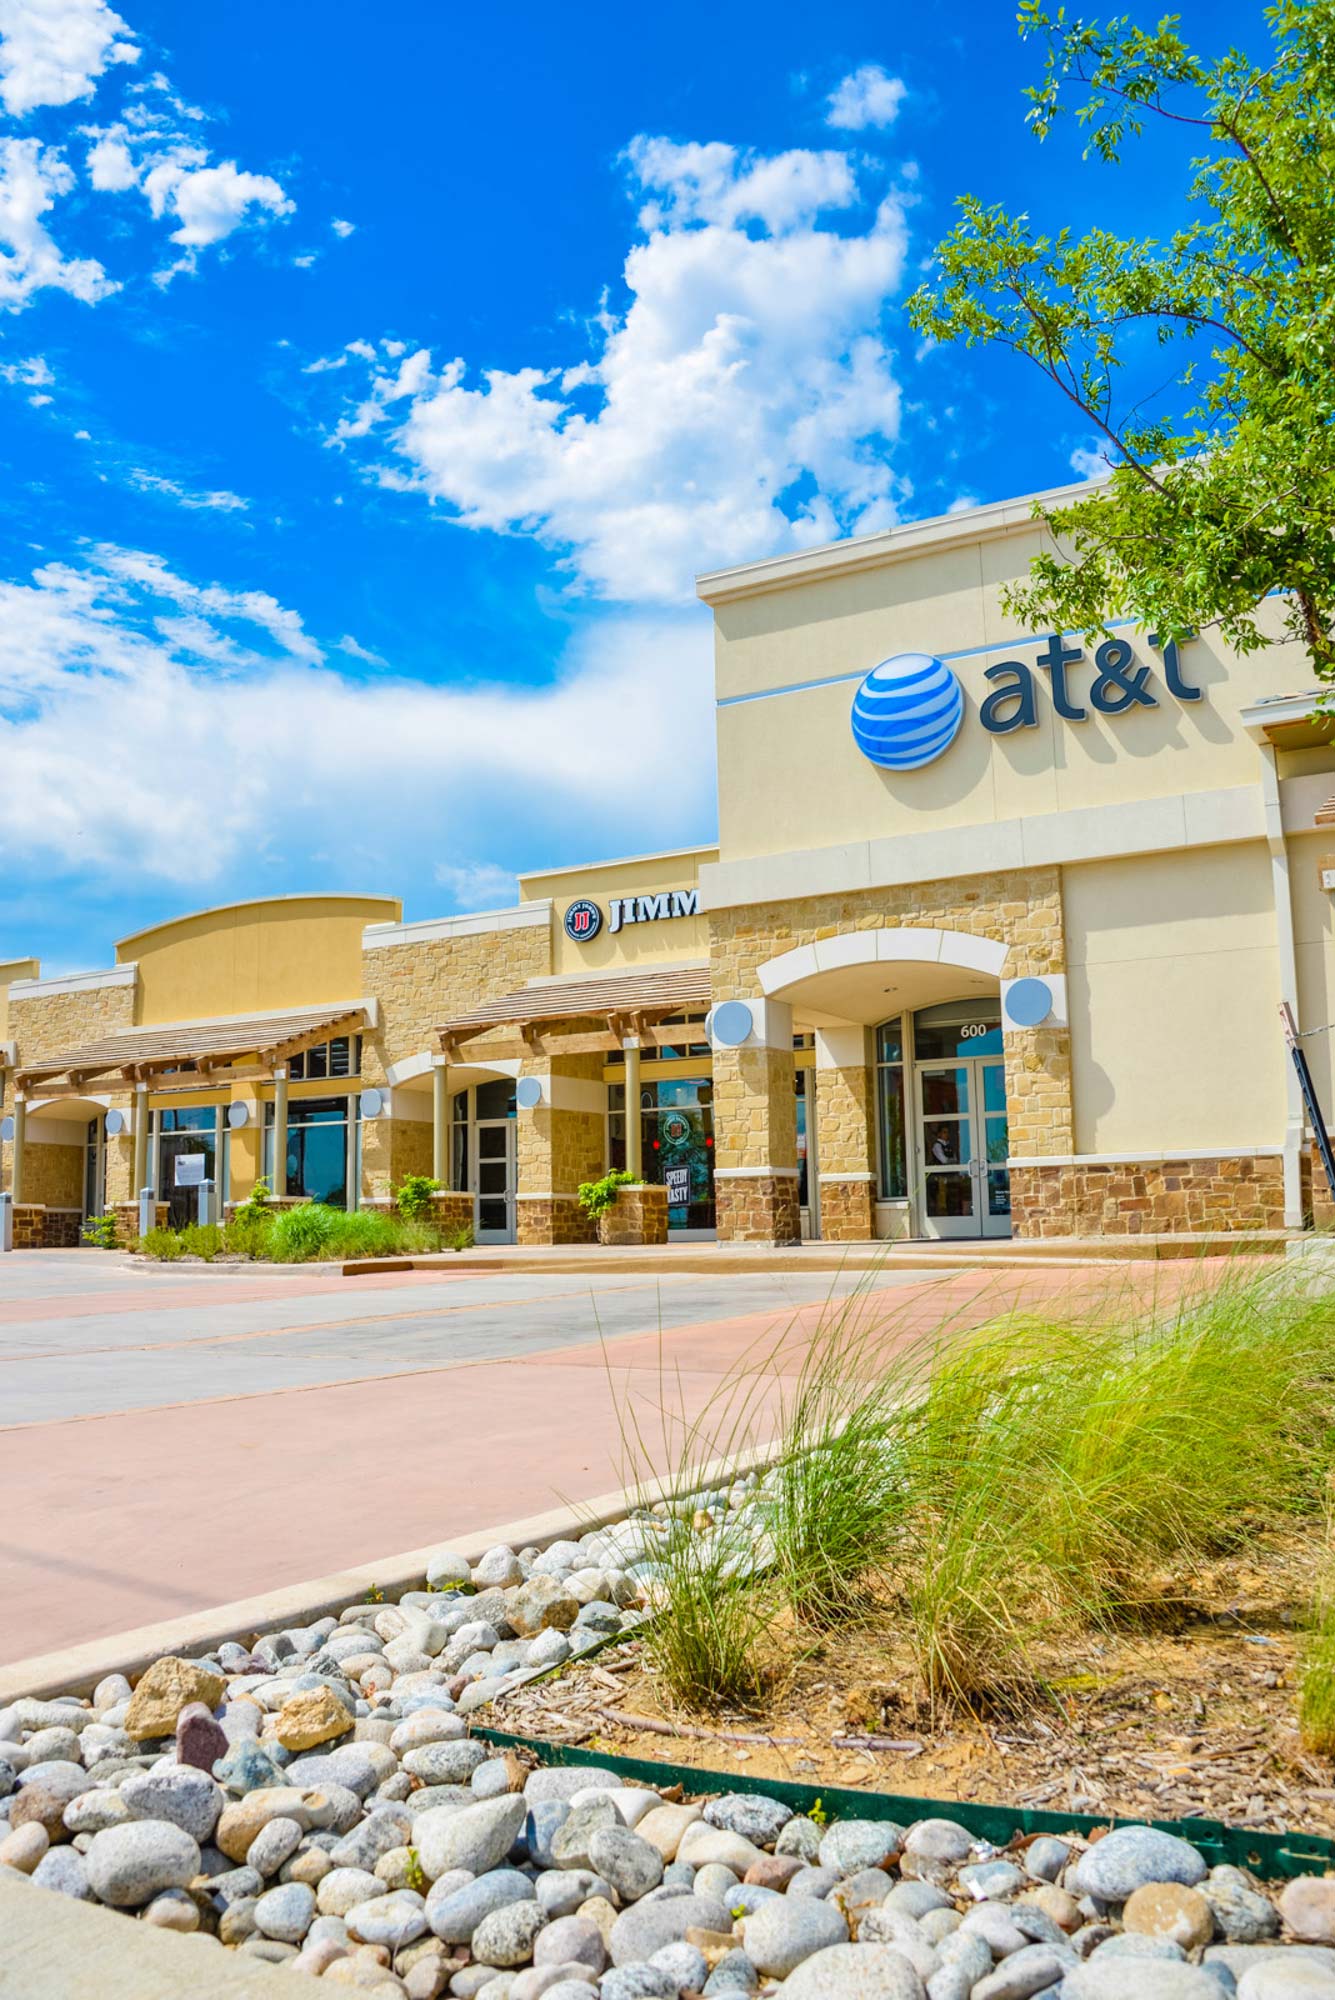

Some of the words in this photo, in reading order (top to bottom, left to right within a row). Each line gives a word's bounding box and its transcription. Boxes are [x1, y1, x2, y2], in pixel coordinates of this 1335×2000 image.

[979, 626, 1202, 734] at&t
[960, 1024, 987, 1038] 600
[665, 1168, 689, 1186] SPEEDY
